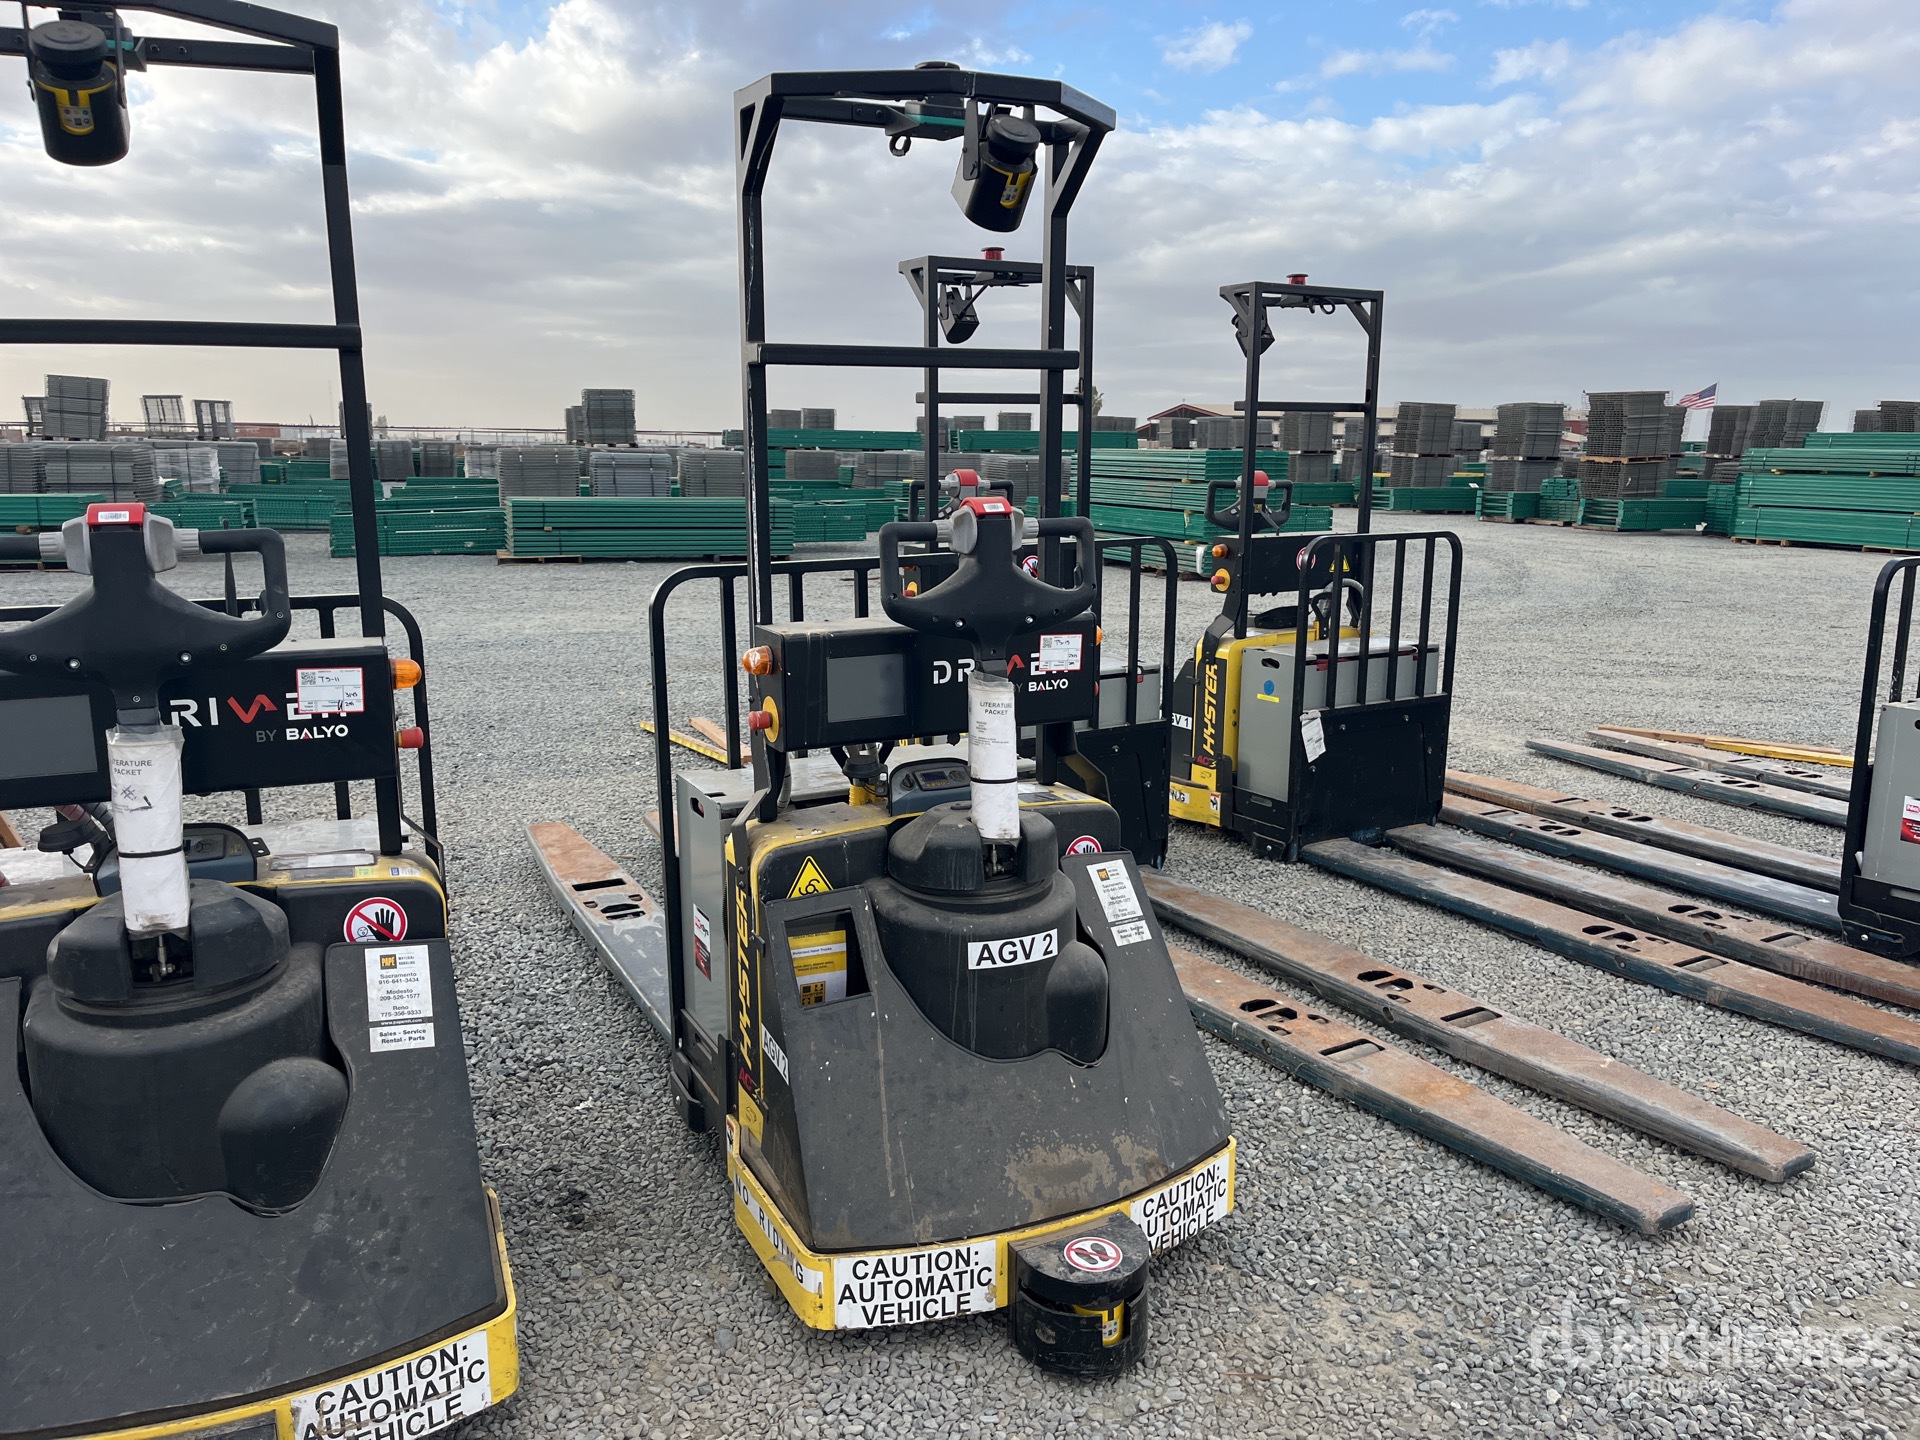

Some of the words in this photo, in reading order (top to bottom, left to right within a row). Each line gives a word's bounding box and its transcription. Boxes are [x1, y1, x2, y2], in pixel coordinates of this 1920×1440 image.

[979, 701, 1013, 709] LITERATURE
[1028, 678, 1069, 692] BALYO
[1203, 663, 1218, 756] HYSTER
[256, 730, 278, 743] BY
[285, 724, 349, 741] BALYO
[975, 936, 1036, 967] AGV
[1043, 933, 1053, 957] 2
[378, 977, 419, 985] 916-641-3434
[735, 885, 752, 1071] HYSTER
[763, 1030, 781, 1068] AGV
[781, 1055, 788, 1080] 2
[735, 1173, 749, 1206] NO
[1138, 1178, 1226, 1238] UTOMATIC
[1143, 1164, 1220, 1218] CAUTION:
[1148, 1205, 1214, 1254] VEHICLE
[852, 1247, 979, 1280] CAUTION:
[838, 1266, 993, 1305] AUTOMATIC
[861, 1292, 971, 1326] VEHICLE
[303, 1358, 486, 1440] AUTOMATIC
[315, 1342, 469, 1416] CAUTION:
[352, 1393, 464, 1440] EHICLE
